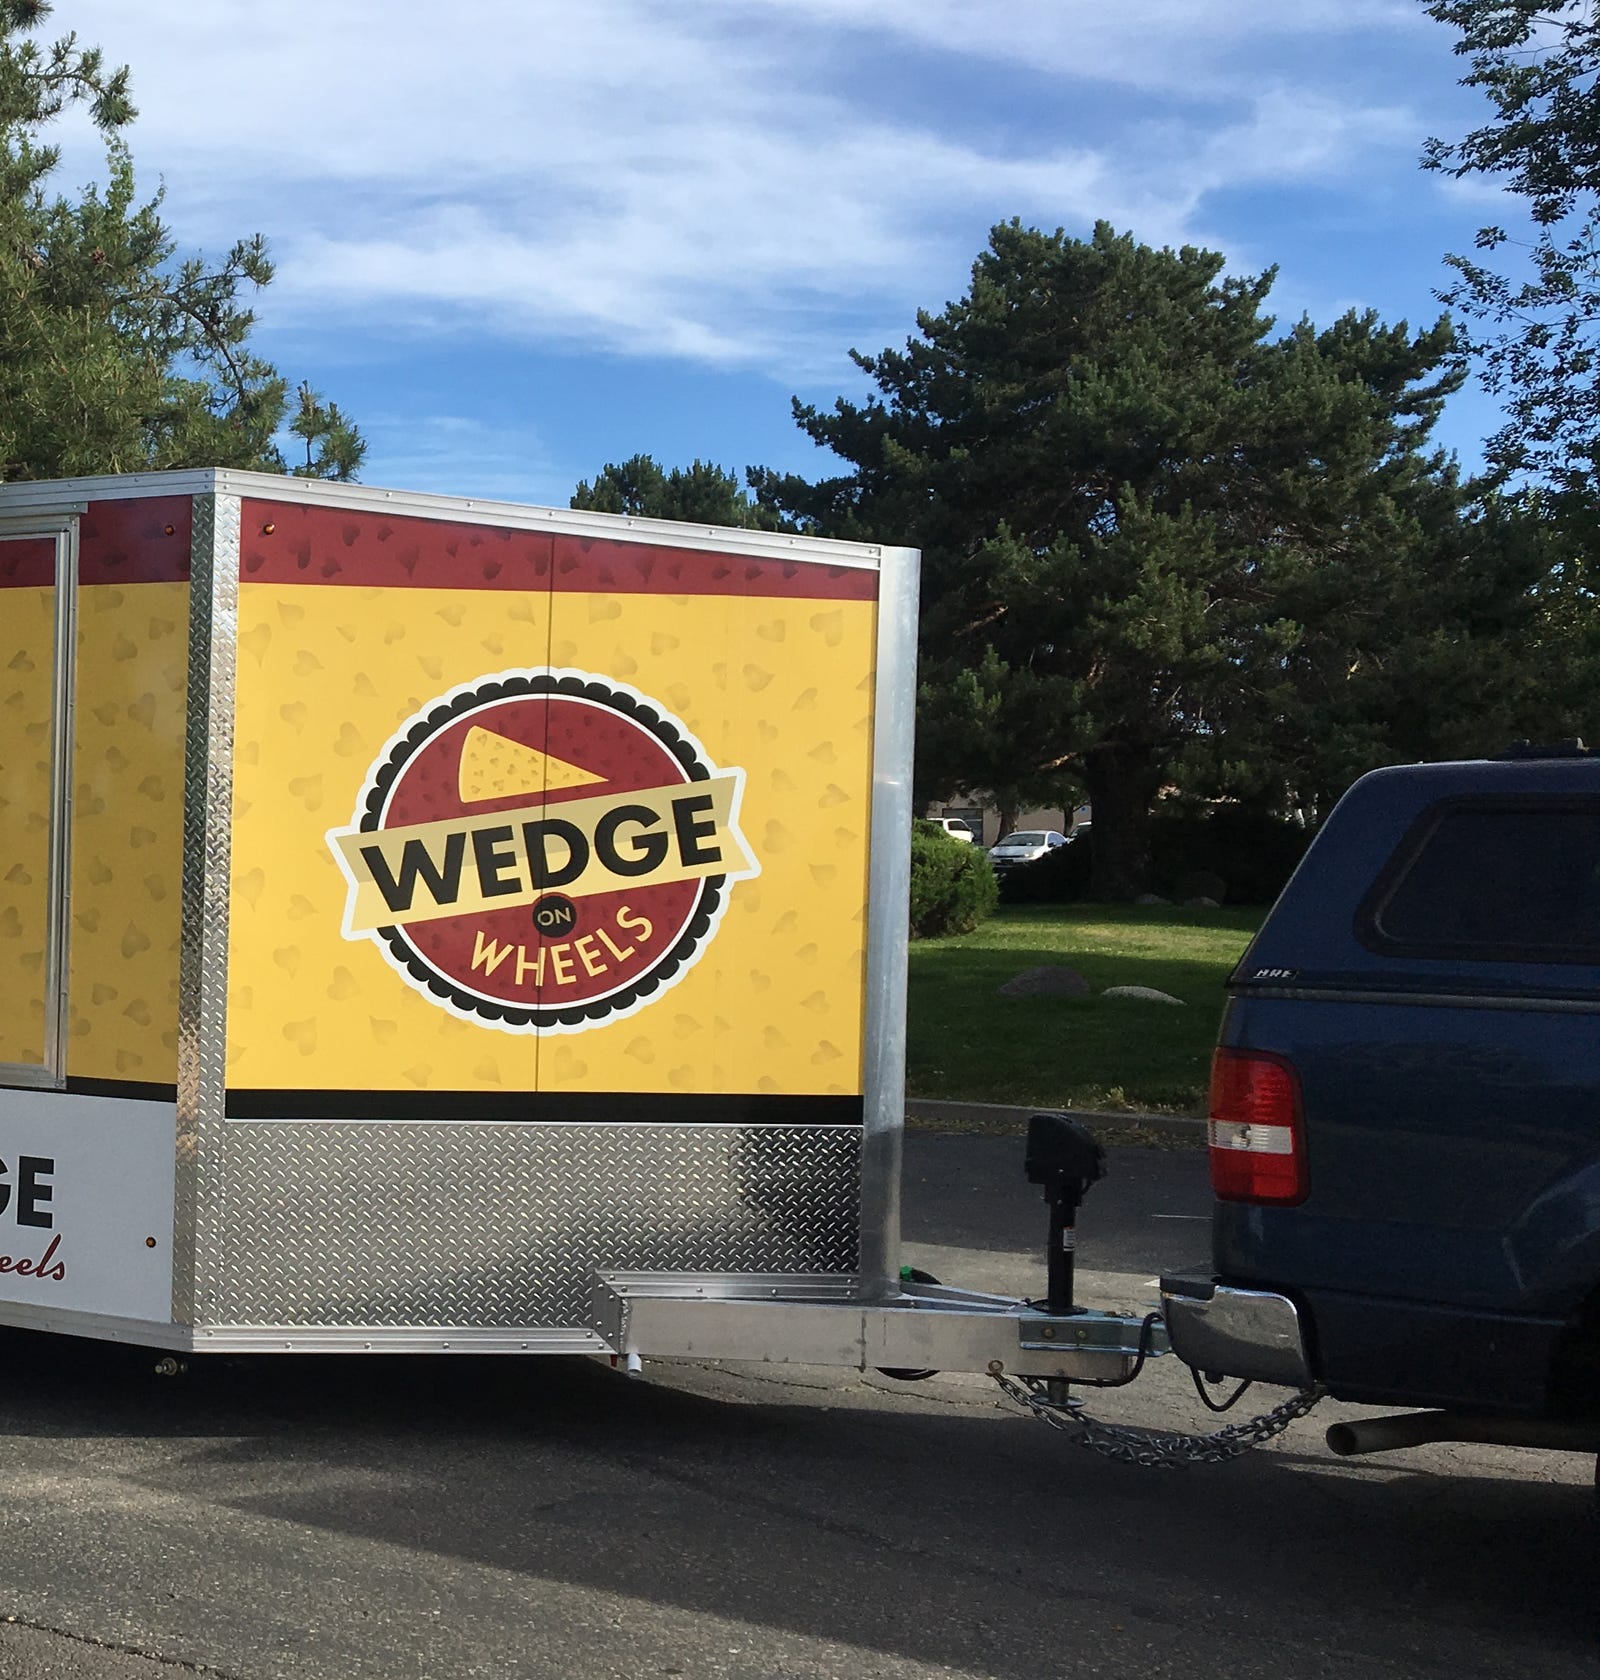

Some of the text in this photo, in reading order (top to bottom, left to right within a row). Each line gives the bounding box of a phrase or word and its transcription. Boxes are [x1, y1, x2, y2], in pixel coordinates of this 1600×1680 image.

[359, 793, 723, 913] WEDGE
[470, 904, 653, 988] WHEELS
[537, 906, 572, 928] ON
